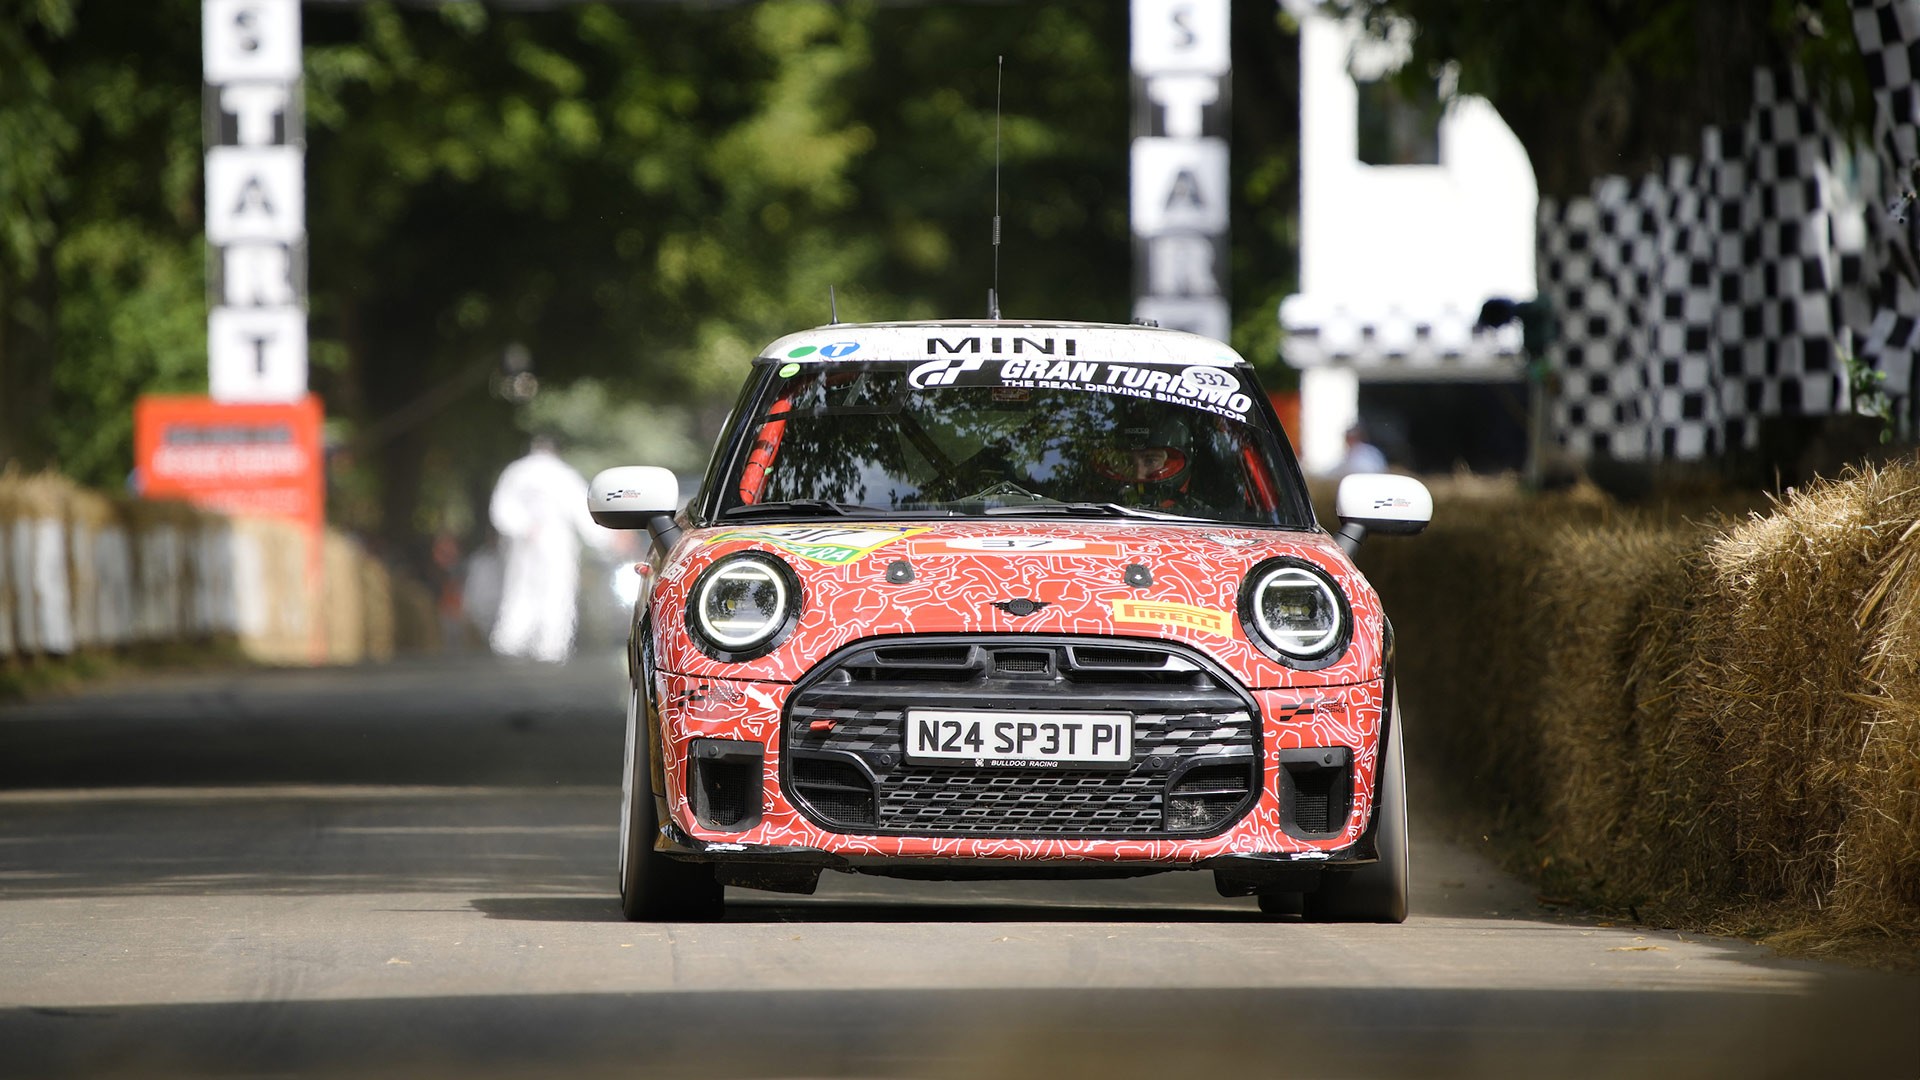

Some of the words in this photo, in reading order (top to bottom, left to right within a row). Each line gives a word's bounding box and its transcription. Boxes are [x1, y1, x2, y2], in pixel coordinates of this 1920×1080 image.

[221, 6, 290, 375] START
[927, 337, 1076, 356] MINI
[1000, 360, 1099, 382] GRAN
[1106, 365, 1252, 413] TURISMO
[1193, 372, 1230, 388] 532
[1002, 379, 1034, 388] THE
[1038, 380, 1082, 391] REAL
[1085, 383, 1152, 399] DRIVING
[1155, 392, 1247, 424] SIMULATOR
[982, 539, 1053, 548] 37
[1123, 603, 1222, 630] PIRELLI
[918, 720, 985, 753] N24
[994, 721, 1083, 755] SP3T
[991, 759, 1027, 767] BULLDOG
[1029, 760, 1058, 768] RACING
